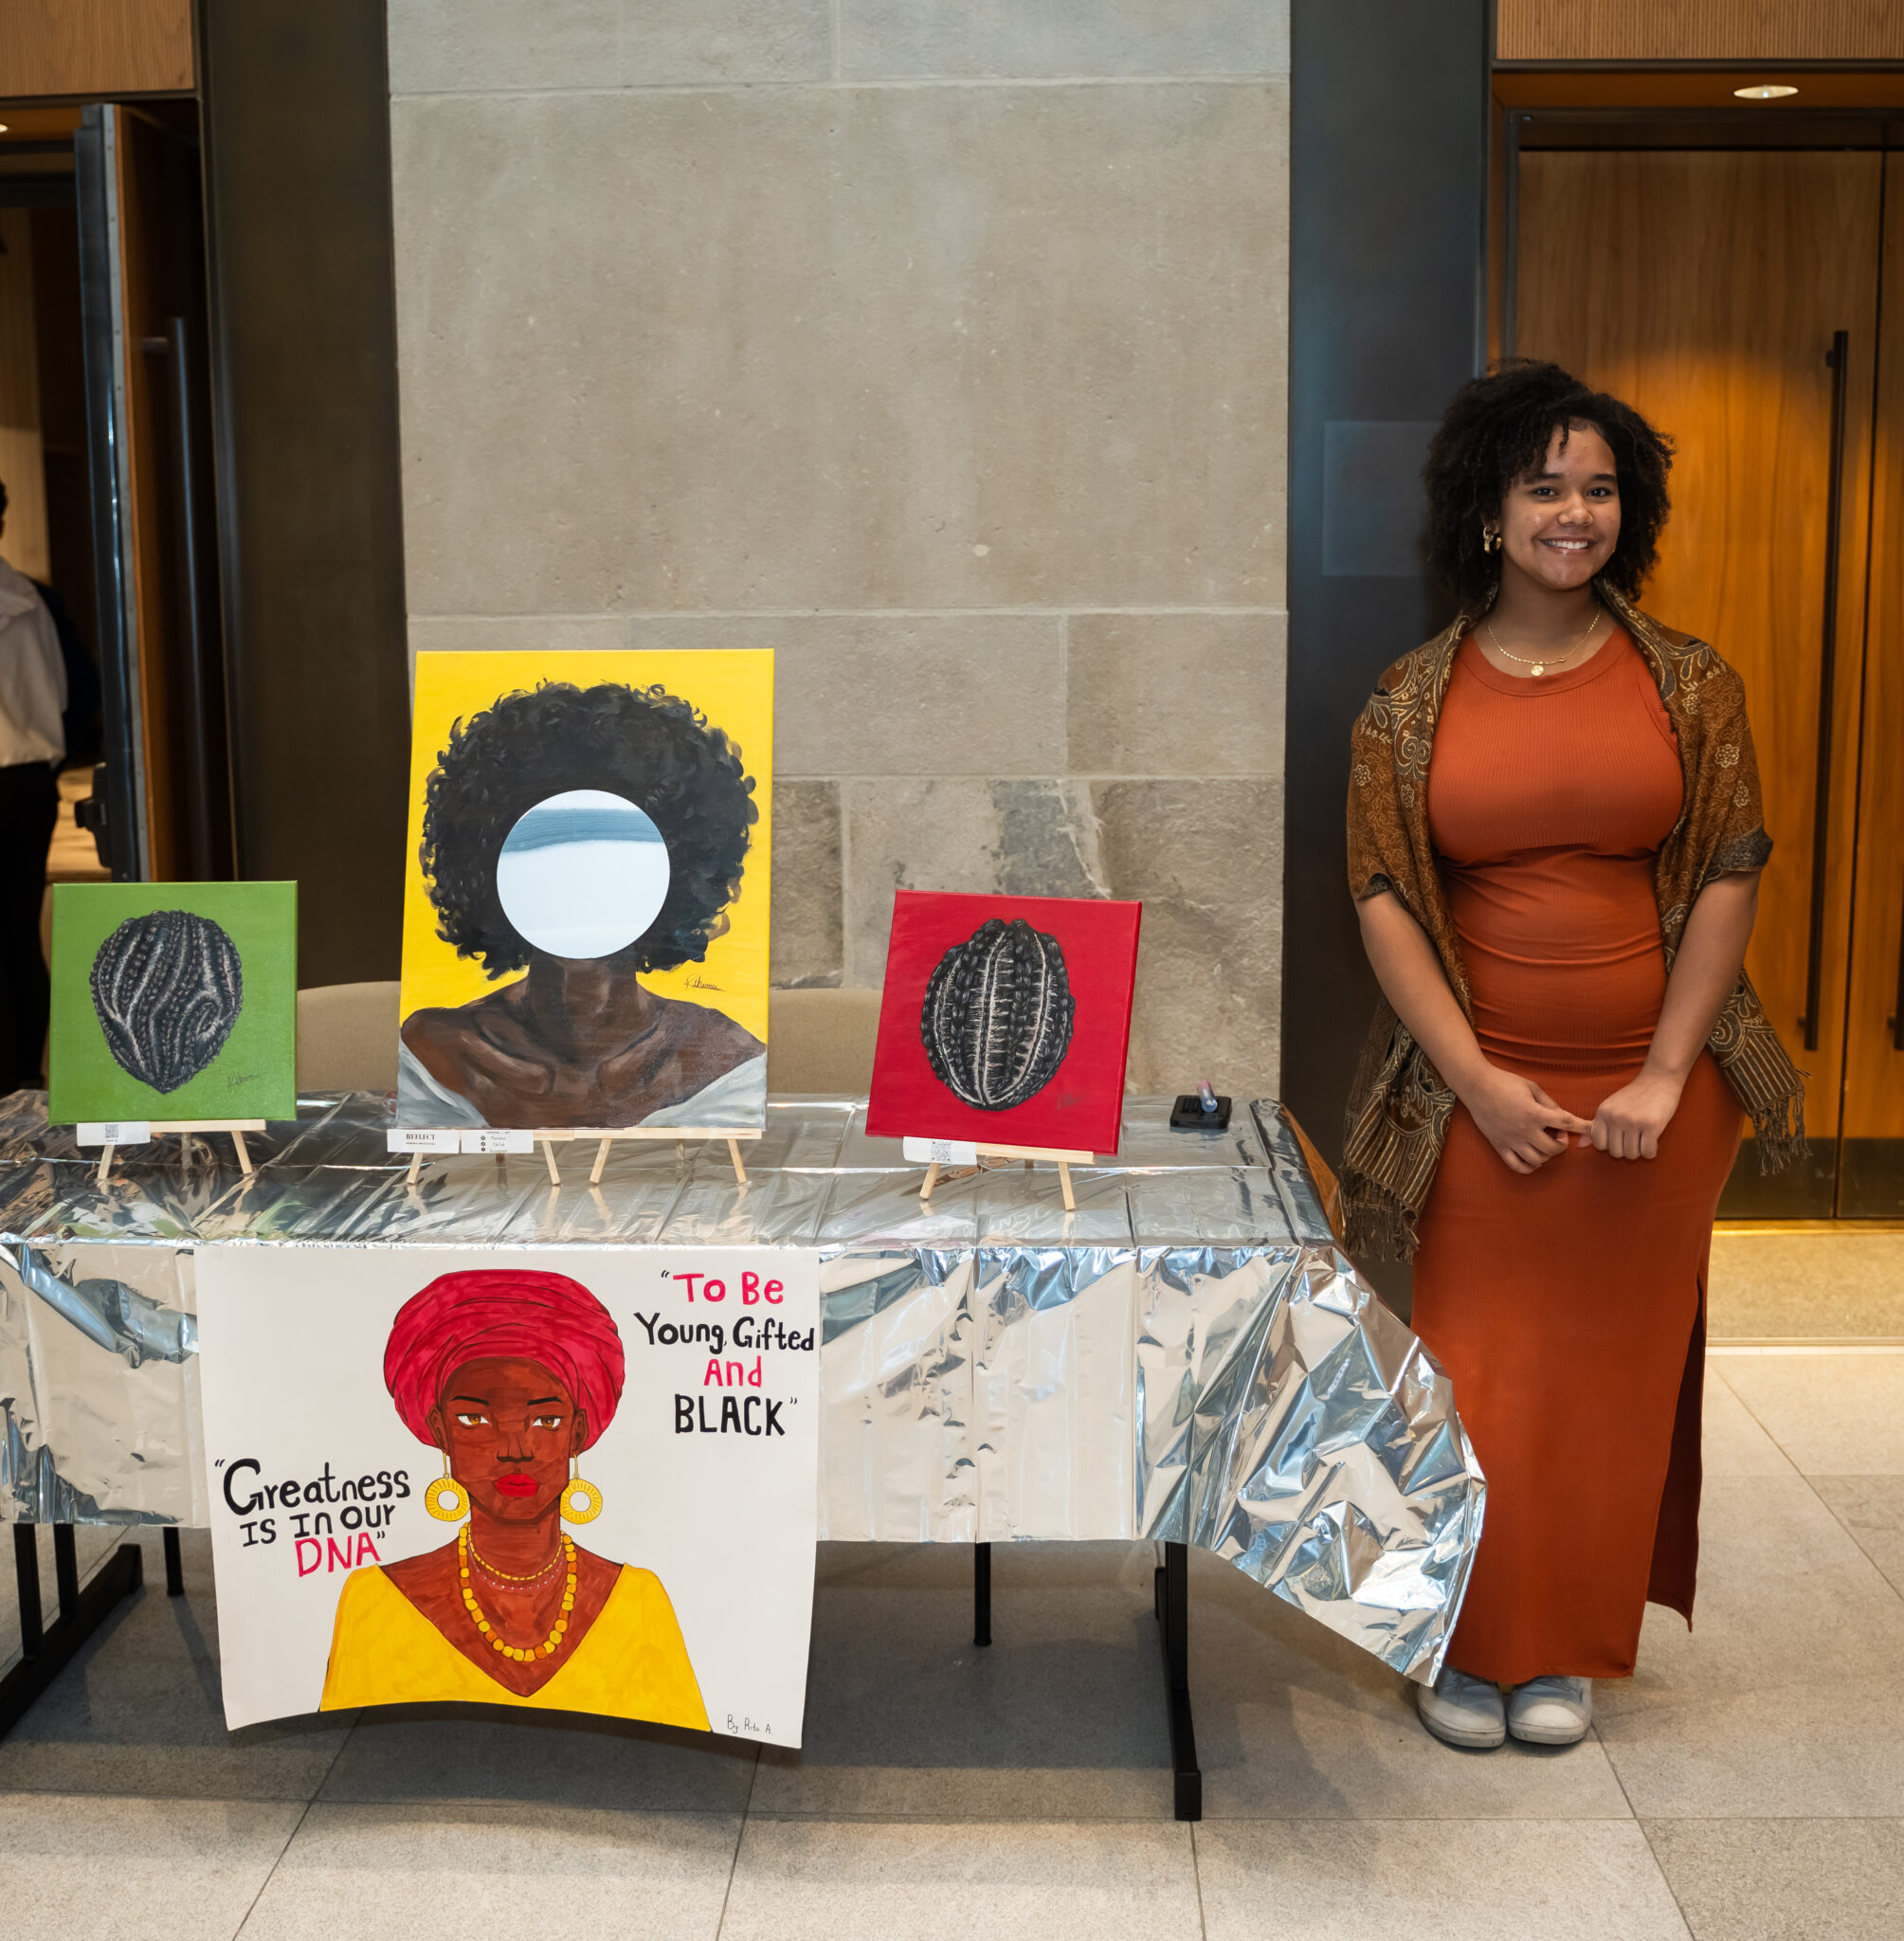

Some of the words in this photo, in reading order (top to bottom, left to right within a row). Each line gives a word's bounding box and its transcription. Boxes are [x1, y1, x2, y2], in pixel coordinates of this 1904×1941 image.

[742, 1272, 784, 1306] Be
[633, 1313, 727, 1355] Young,
[733, 1316, 815, 1351] Gifted
[704, 1355, 762, 1388] And
[675, 1394, 798, 1437] BLACK”
[214, 1459, 411, 1516] “Greatness
[289, 1513, 334, 1539] In
[295, 1530, 386, 1578] DNA”
[727, 1714, 739, 1734] By
